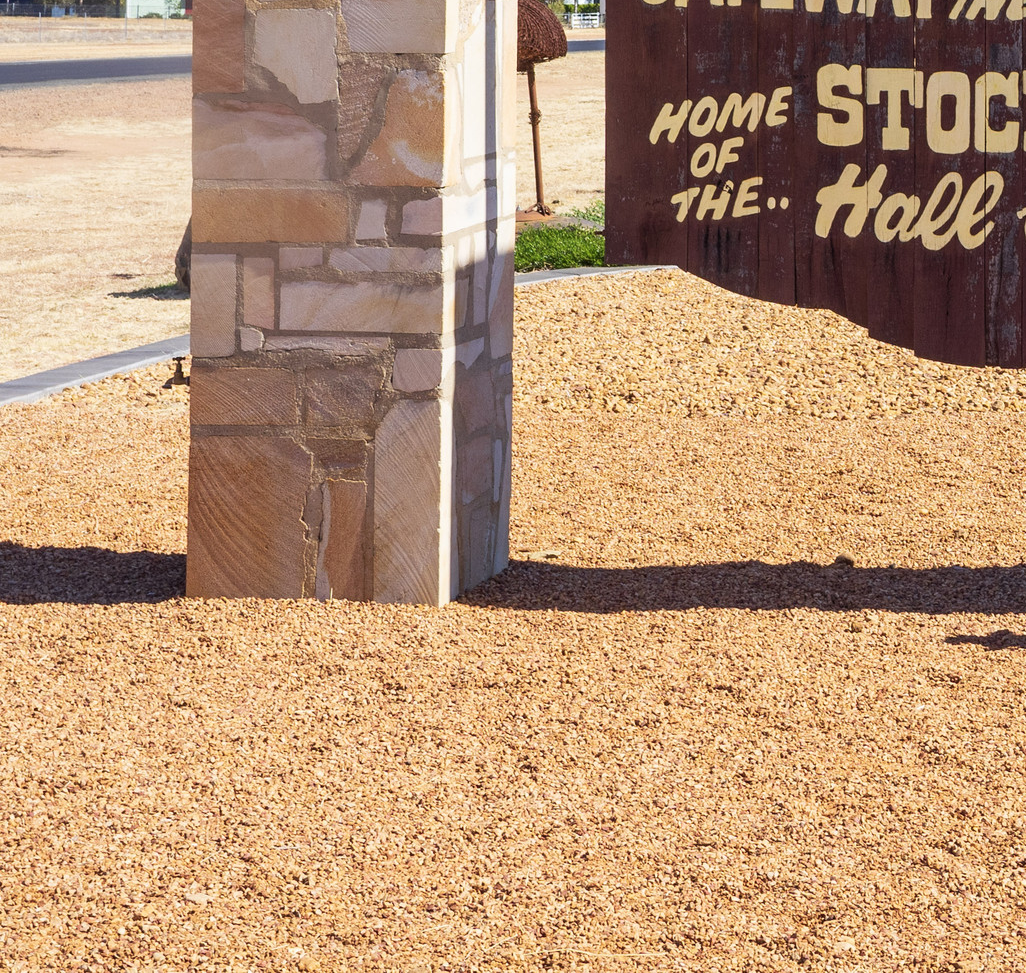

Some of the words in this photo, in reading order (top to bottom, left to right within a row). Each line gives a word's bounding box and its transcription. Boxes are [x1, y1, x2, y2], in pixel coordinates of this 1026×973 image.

[649, 86, 793, 144] HOME
[690, 137, 745, 178] OF
[814, 164, 1004, 251] Hall
